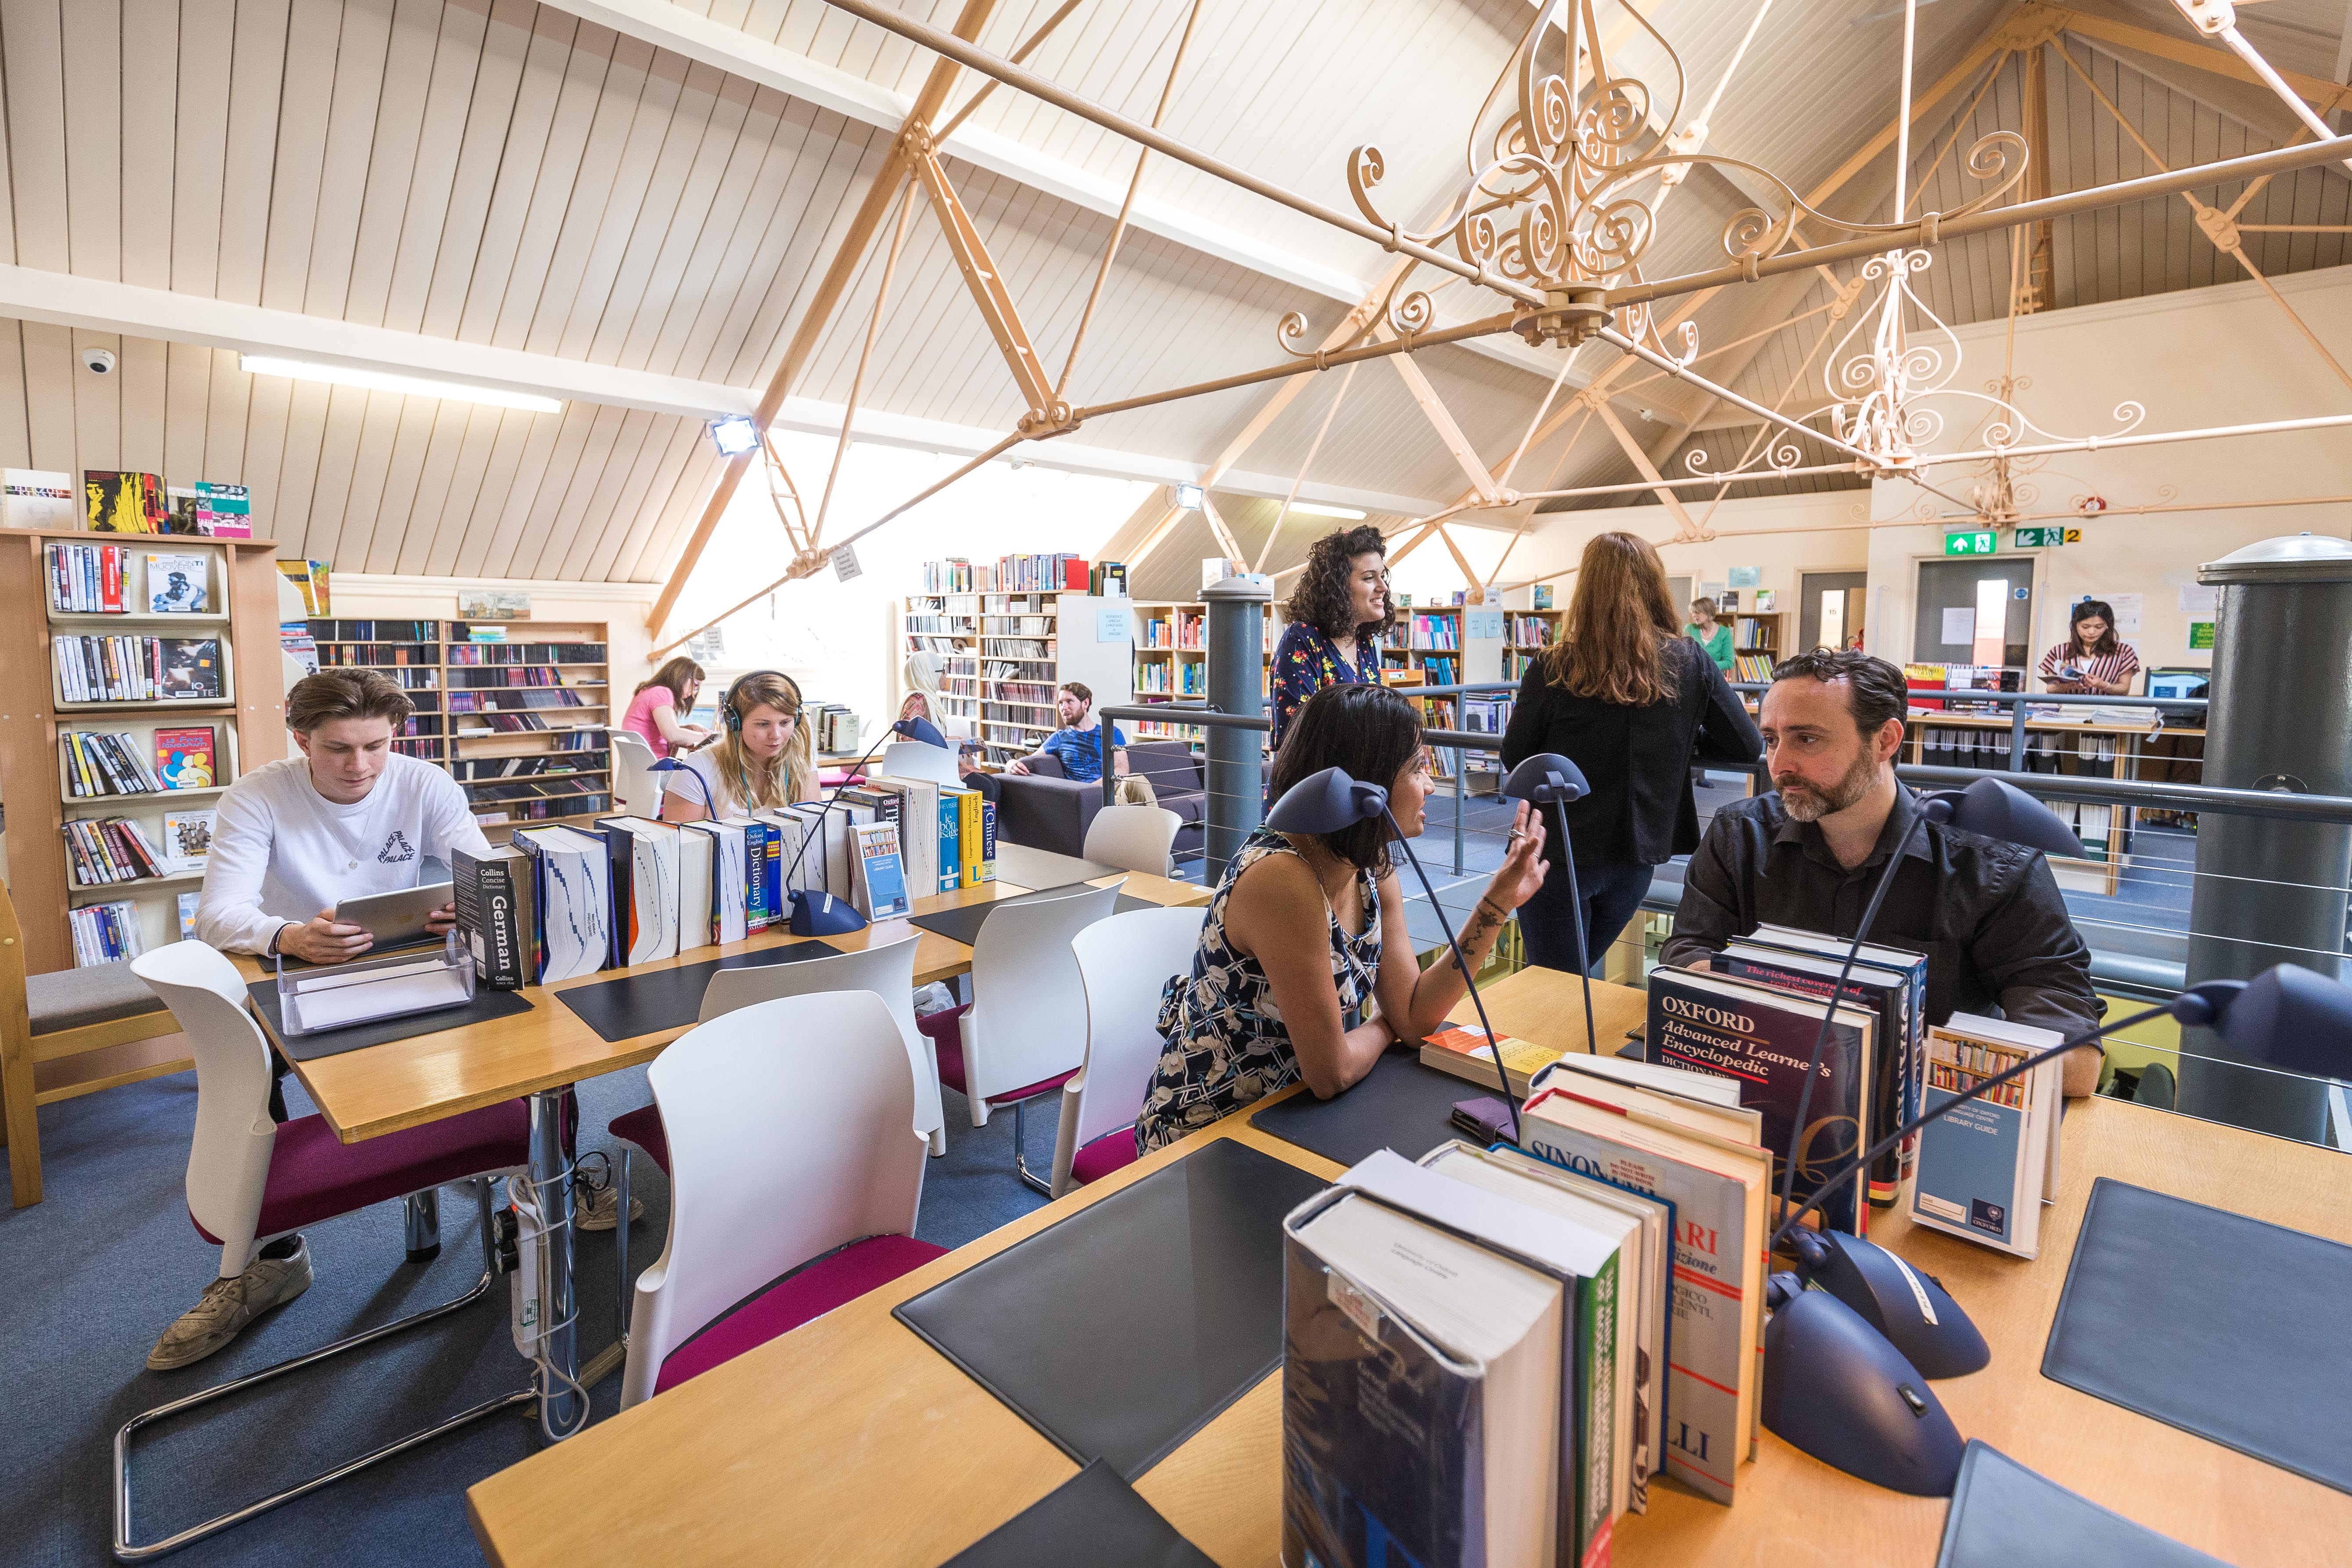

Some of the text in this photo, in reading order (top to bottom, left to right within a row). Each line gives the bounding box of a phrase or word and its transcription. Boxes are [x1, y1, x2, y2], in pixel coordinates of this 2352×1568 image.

[2067, 529, 2079, 542] 2
[940, 821, 956, 831] bon
[945, 813, 952, 823] le
[393, 831, 415, 853] PALACE
[986, 812, 994, 857] Chinese
[377, 833, 396, 863] PALACE
[382, 853, 415, 864] PALACE
[750, 846, 762, 907] Dictionary
[972, 866, 981, 882] L
[492, 895, 511, 971] German
[1746, 966, 1863, 996] The richest coverae of
[1662, 996, 1755, 1033] OXFORD
[1662, 1020, 1831, 1078] Advanced Learne's
[1662, 1034, 1769, 1075] Encyclopedic
[1975, 1115, 1995, 1123] CENTRE
[1981, 1109, 2001, 1119] OXFORD
[1944, 1115, 1999, 1135] LIBRARY GUIDE
[1620, 1158, 1645, 1172] PLEASE
[1621, 1165, 1635, 1175] NOT
[1636, 1169, 1655, 1182] WRITE
[1636, 1176, 1654, 1187] BOOK
[1973, 1219, 2001, 1233] OXFORD
[1391, 1248, 1423, 1268] Language
